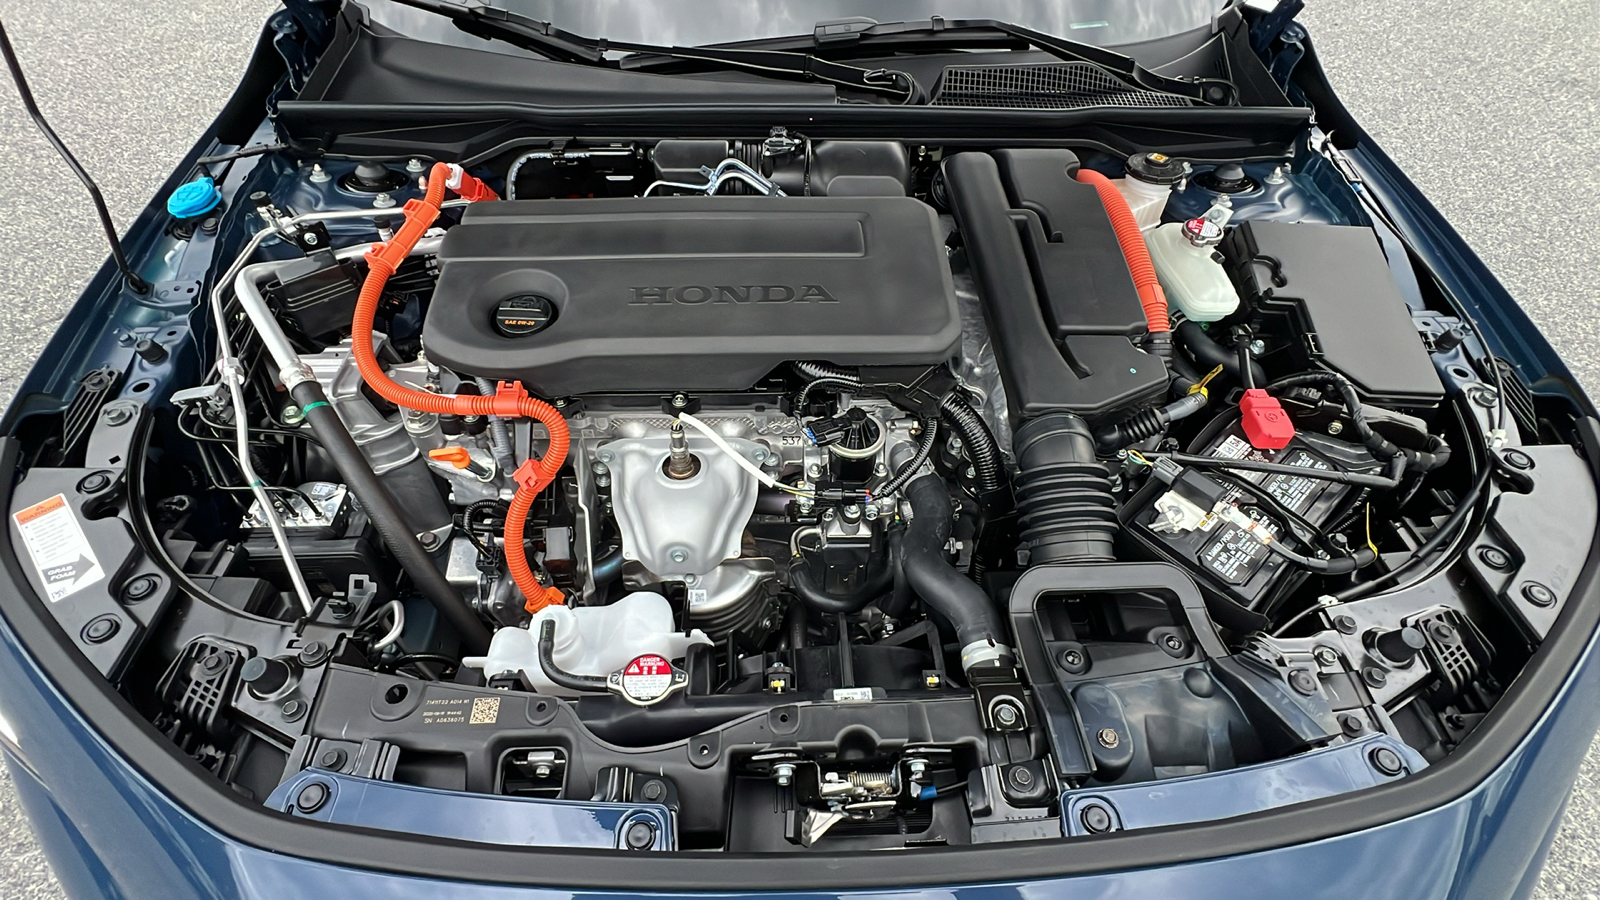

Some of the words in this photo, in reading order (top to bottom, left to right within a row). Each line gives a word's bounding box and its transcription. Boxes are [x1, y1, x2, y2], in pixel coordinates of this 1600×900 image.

[628, 284, 840, 306] HONDA
[782, 436, 801, 445] 537
[20, 501, 63, 523] WARNING
[47, 565, 73, 576] GRAB
[50, 570, 77, 581] FOAM
